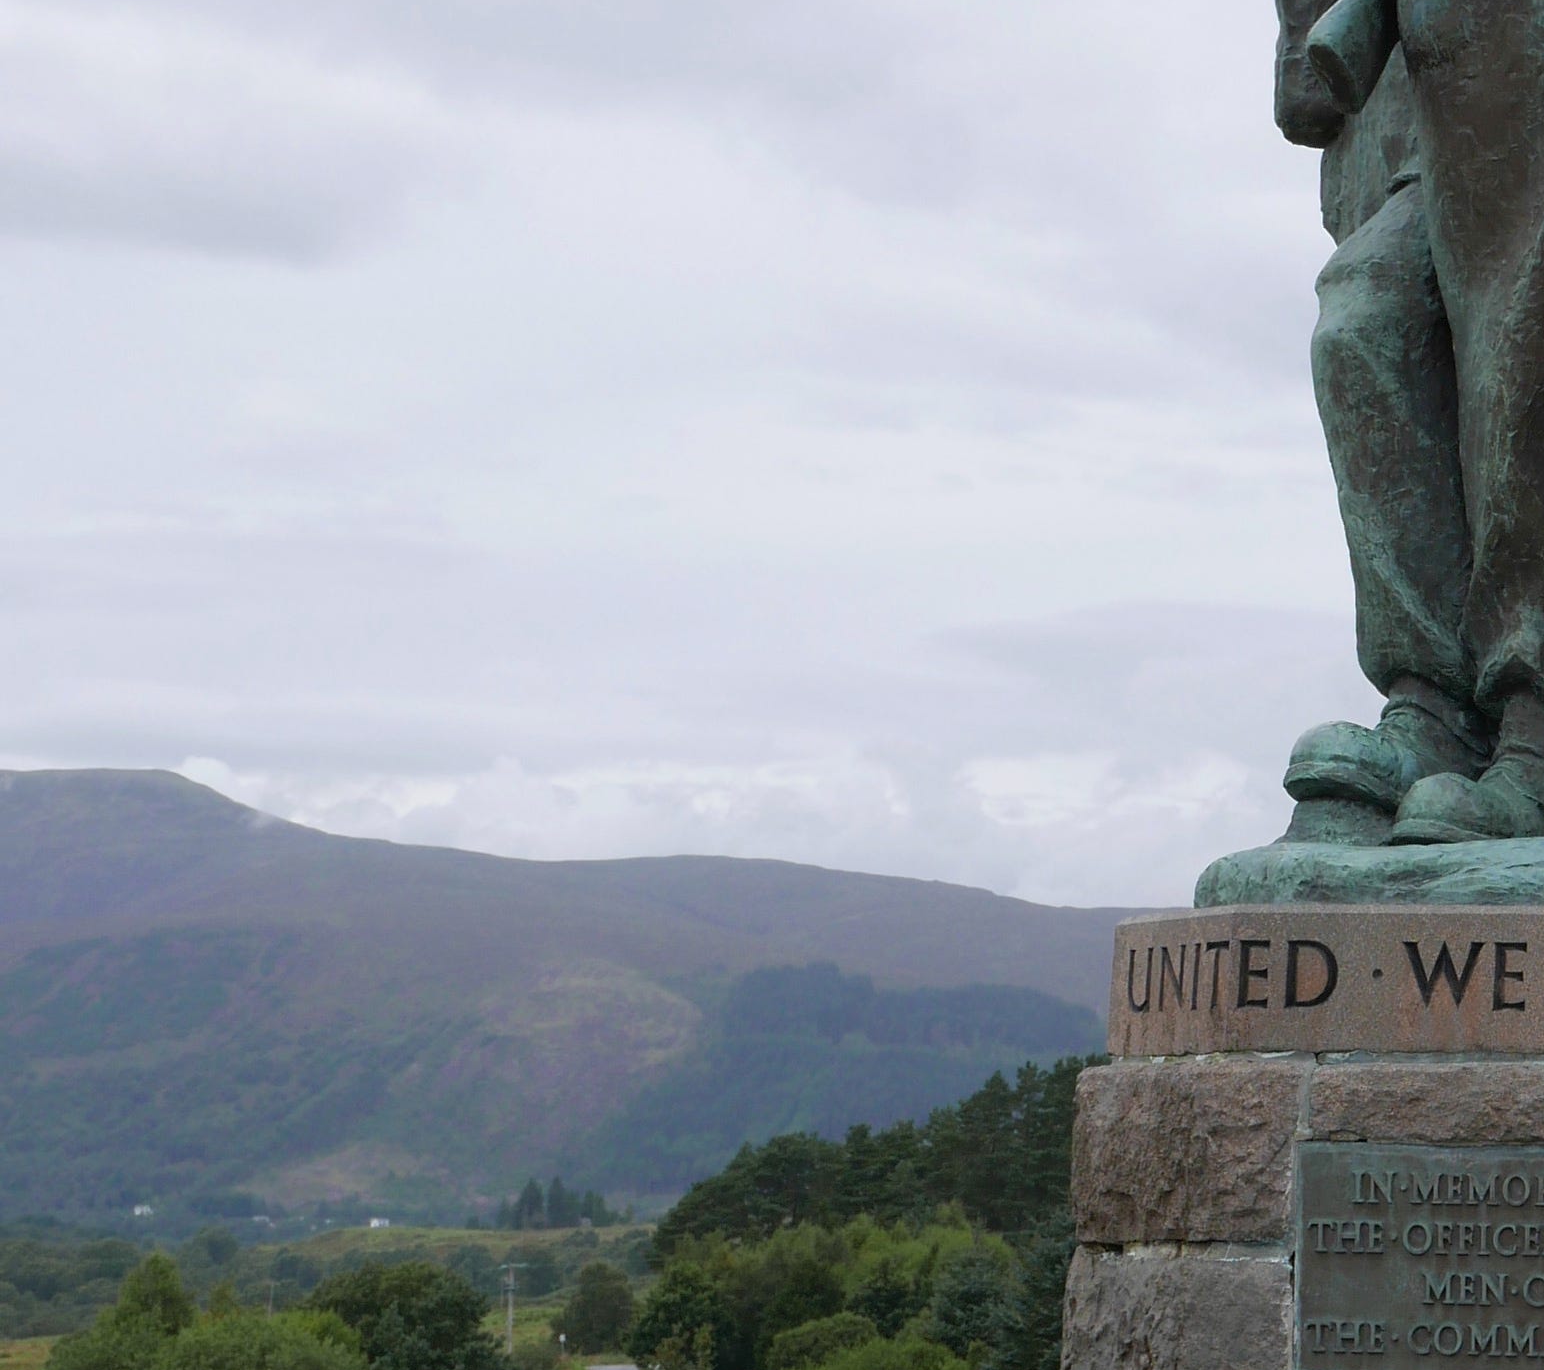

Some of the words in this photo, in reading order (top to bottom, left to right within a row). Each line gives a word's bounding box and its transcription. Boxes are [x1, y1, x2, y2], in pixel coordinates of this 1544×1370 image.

[1127, 939, 1339, 1013] UNITED
[1402, 941, 1531, 1011] WE
[1351, 1171, 1397, 1205] IN
[1308, 1219, 1386, 1254] THE
[1422, 1271, 1509, 1306] MEN
[1304, 1319, 1386, 1354] THE
